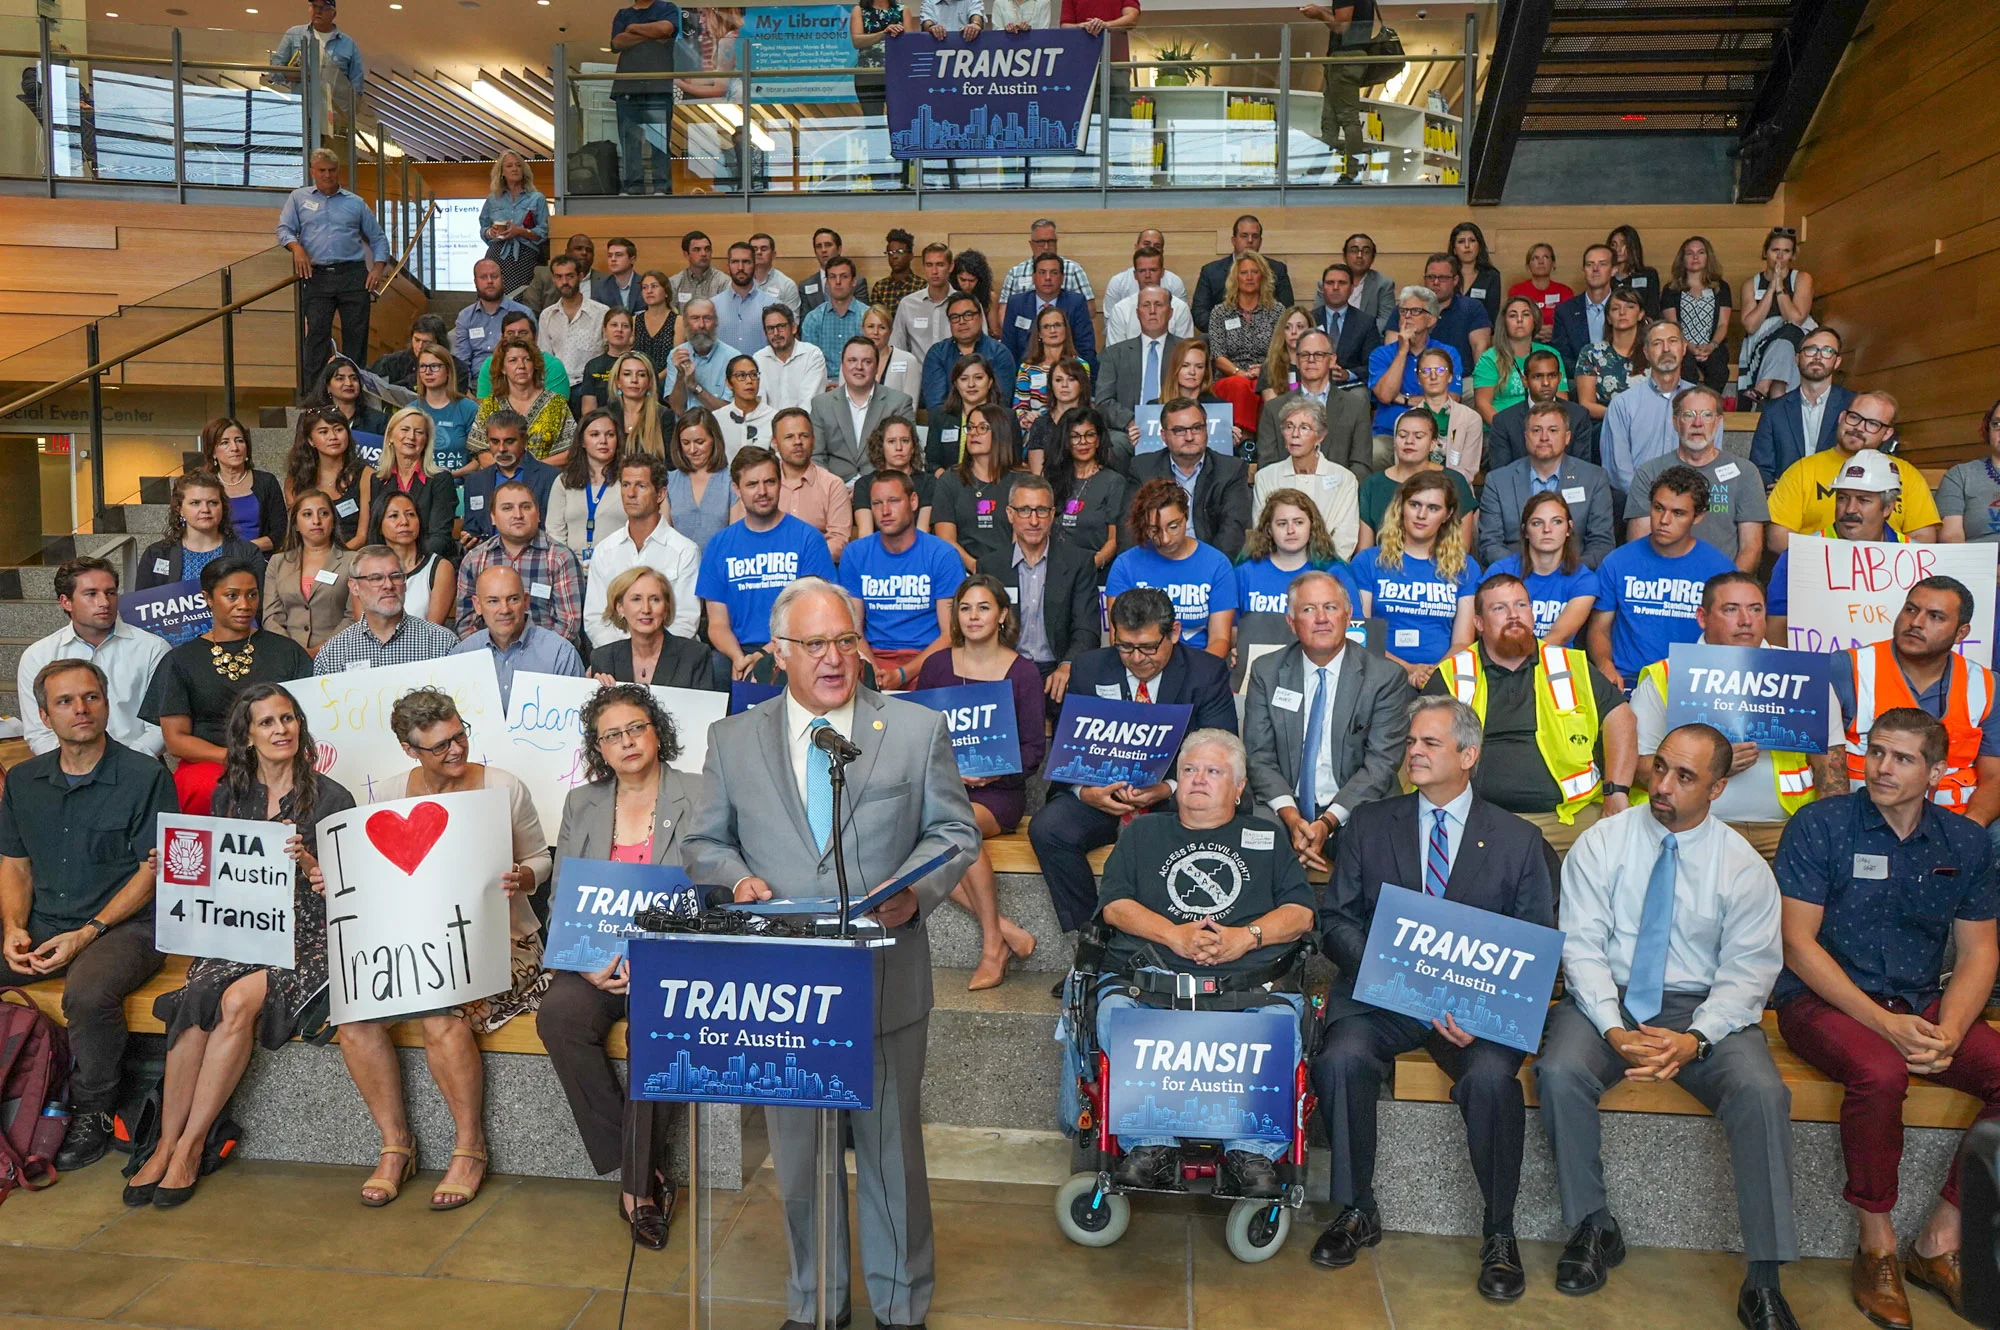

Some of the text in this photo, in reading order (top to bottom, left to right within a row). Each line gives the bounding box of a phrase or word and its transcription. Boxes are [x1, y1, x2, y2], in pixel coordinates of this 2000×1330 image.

[756, 14, 848, 32] My Library
[755, 31, 848, 40] MORE THAN BOOKS
[935, 48, 1064, 79] TRANSIT
[962, 82, 1038, 95] for Austin
[454, 205, 480, 213] Events
[50, 405, 89, 421] Even
[101, 406, 155, 422] Center
[726, 552, 798, 579] TexPIRG
[1825, 545, 1937, 592] LABOR
[737, 583, 745, 591] To
[860, 574, 931, 597] TexPIRG
[1377, 579, 1458, 604] TexPIRG
[1624, 576, 1705, 605] TexPIRG
[135, 593, 207, 621] TRANS
[1248, 591, 1288, 613] TexP
[1395, 605, 1428, 616] Powerful
[1419, 601, 1450, 611] Standing
[1633, 605, 1641, 613] To
[1641, 606, 1671, 616] Powerful
[1663, 601, 1692, 611] Standing
[1847, 603, 1892, 625] FOR
[163, 617, 179, 626] for
[1688, 668, 1810, 700] TRANSIT
[942, 704, 998, 733] NSIT
[1713, 698, 1786, 715] for Austin
[1073, 716, 1173, 748] TRANSIT
[1088, 743, 1148, 761] for Austin
[219, 833, 265, 857] AIA
[327, 823, 356, 898] I
[1159, 848, 1187, 878] ACCESS
[1187, 842, 1197, 853] IS
[1207, 842, 1231, 856] CIVIL
[218, 862, 288, 887] Austin
[1187, 865, 1221, 900] ADAPT
[576, 885, 679, 917] TRANSI
[1167, 904, 1182, 917] WE
[170, 899, 286, 932] 4 Transit
[597, 919, 618, 933] for
[330, 904, 472, 1004] Transit
[1393, 917, 1535, 980] TRANSIT
[1414, 959, 1496, 995] for Austin
[660, 979, 843, 1024] TRANSIT
[698, 1026, 806, 1049] for Austin
[1133, 1039, 1272, 1075] TRANSIT
[1162, 1075, 1245, 1094] for Austin
